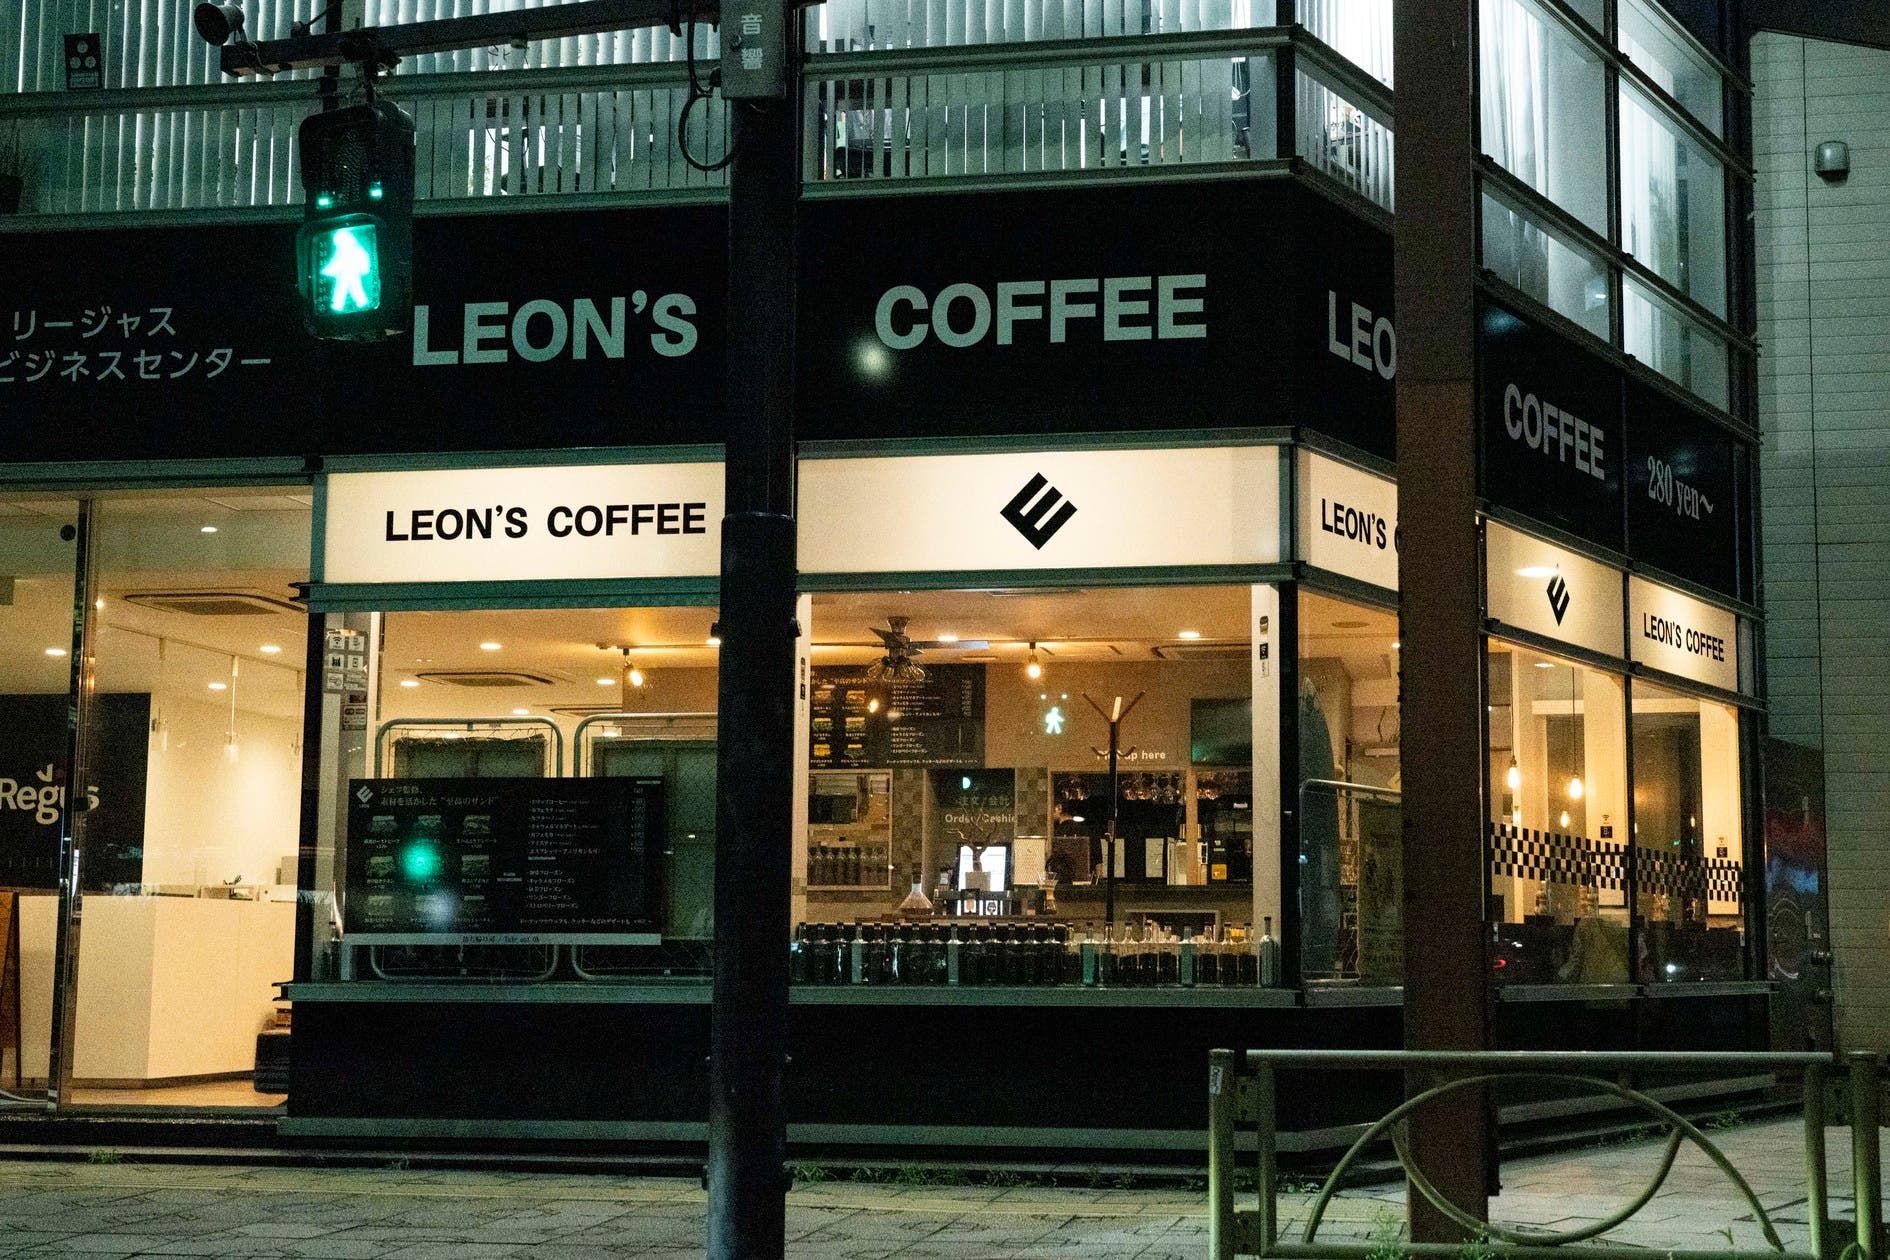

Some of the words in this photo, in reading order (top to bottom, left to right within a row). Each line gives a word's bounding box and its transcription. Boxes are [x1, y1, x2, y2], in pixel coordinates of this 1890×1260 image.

[13, 304, 177, 341] リージャス
[412, 289, 699, 366] LEON'S
[874, 273, 1207, 350] COFFEE
[1503, 383, 1605, 481] COFFEE
[1647, 455, 1673, 507] 280
[386, 504, 529, 542] LEON'S
[547, 502, 707, 538] COFFEE
[1321, 497, 1387, 550] LEON'S
[1643, 612, 1682, 649] LEON'S
[1685, 627, 1725, 663] COFFEE
[1141, 750, 1167, 760] here
